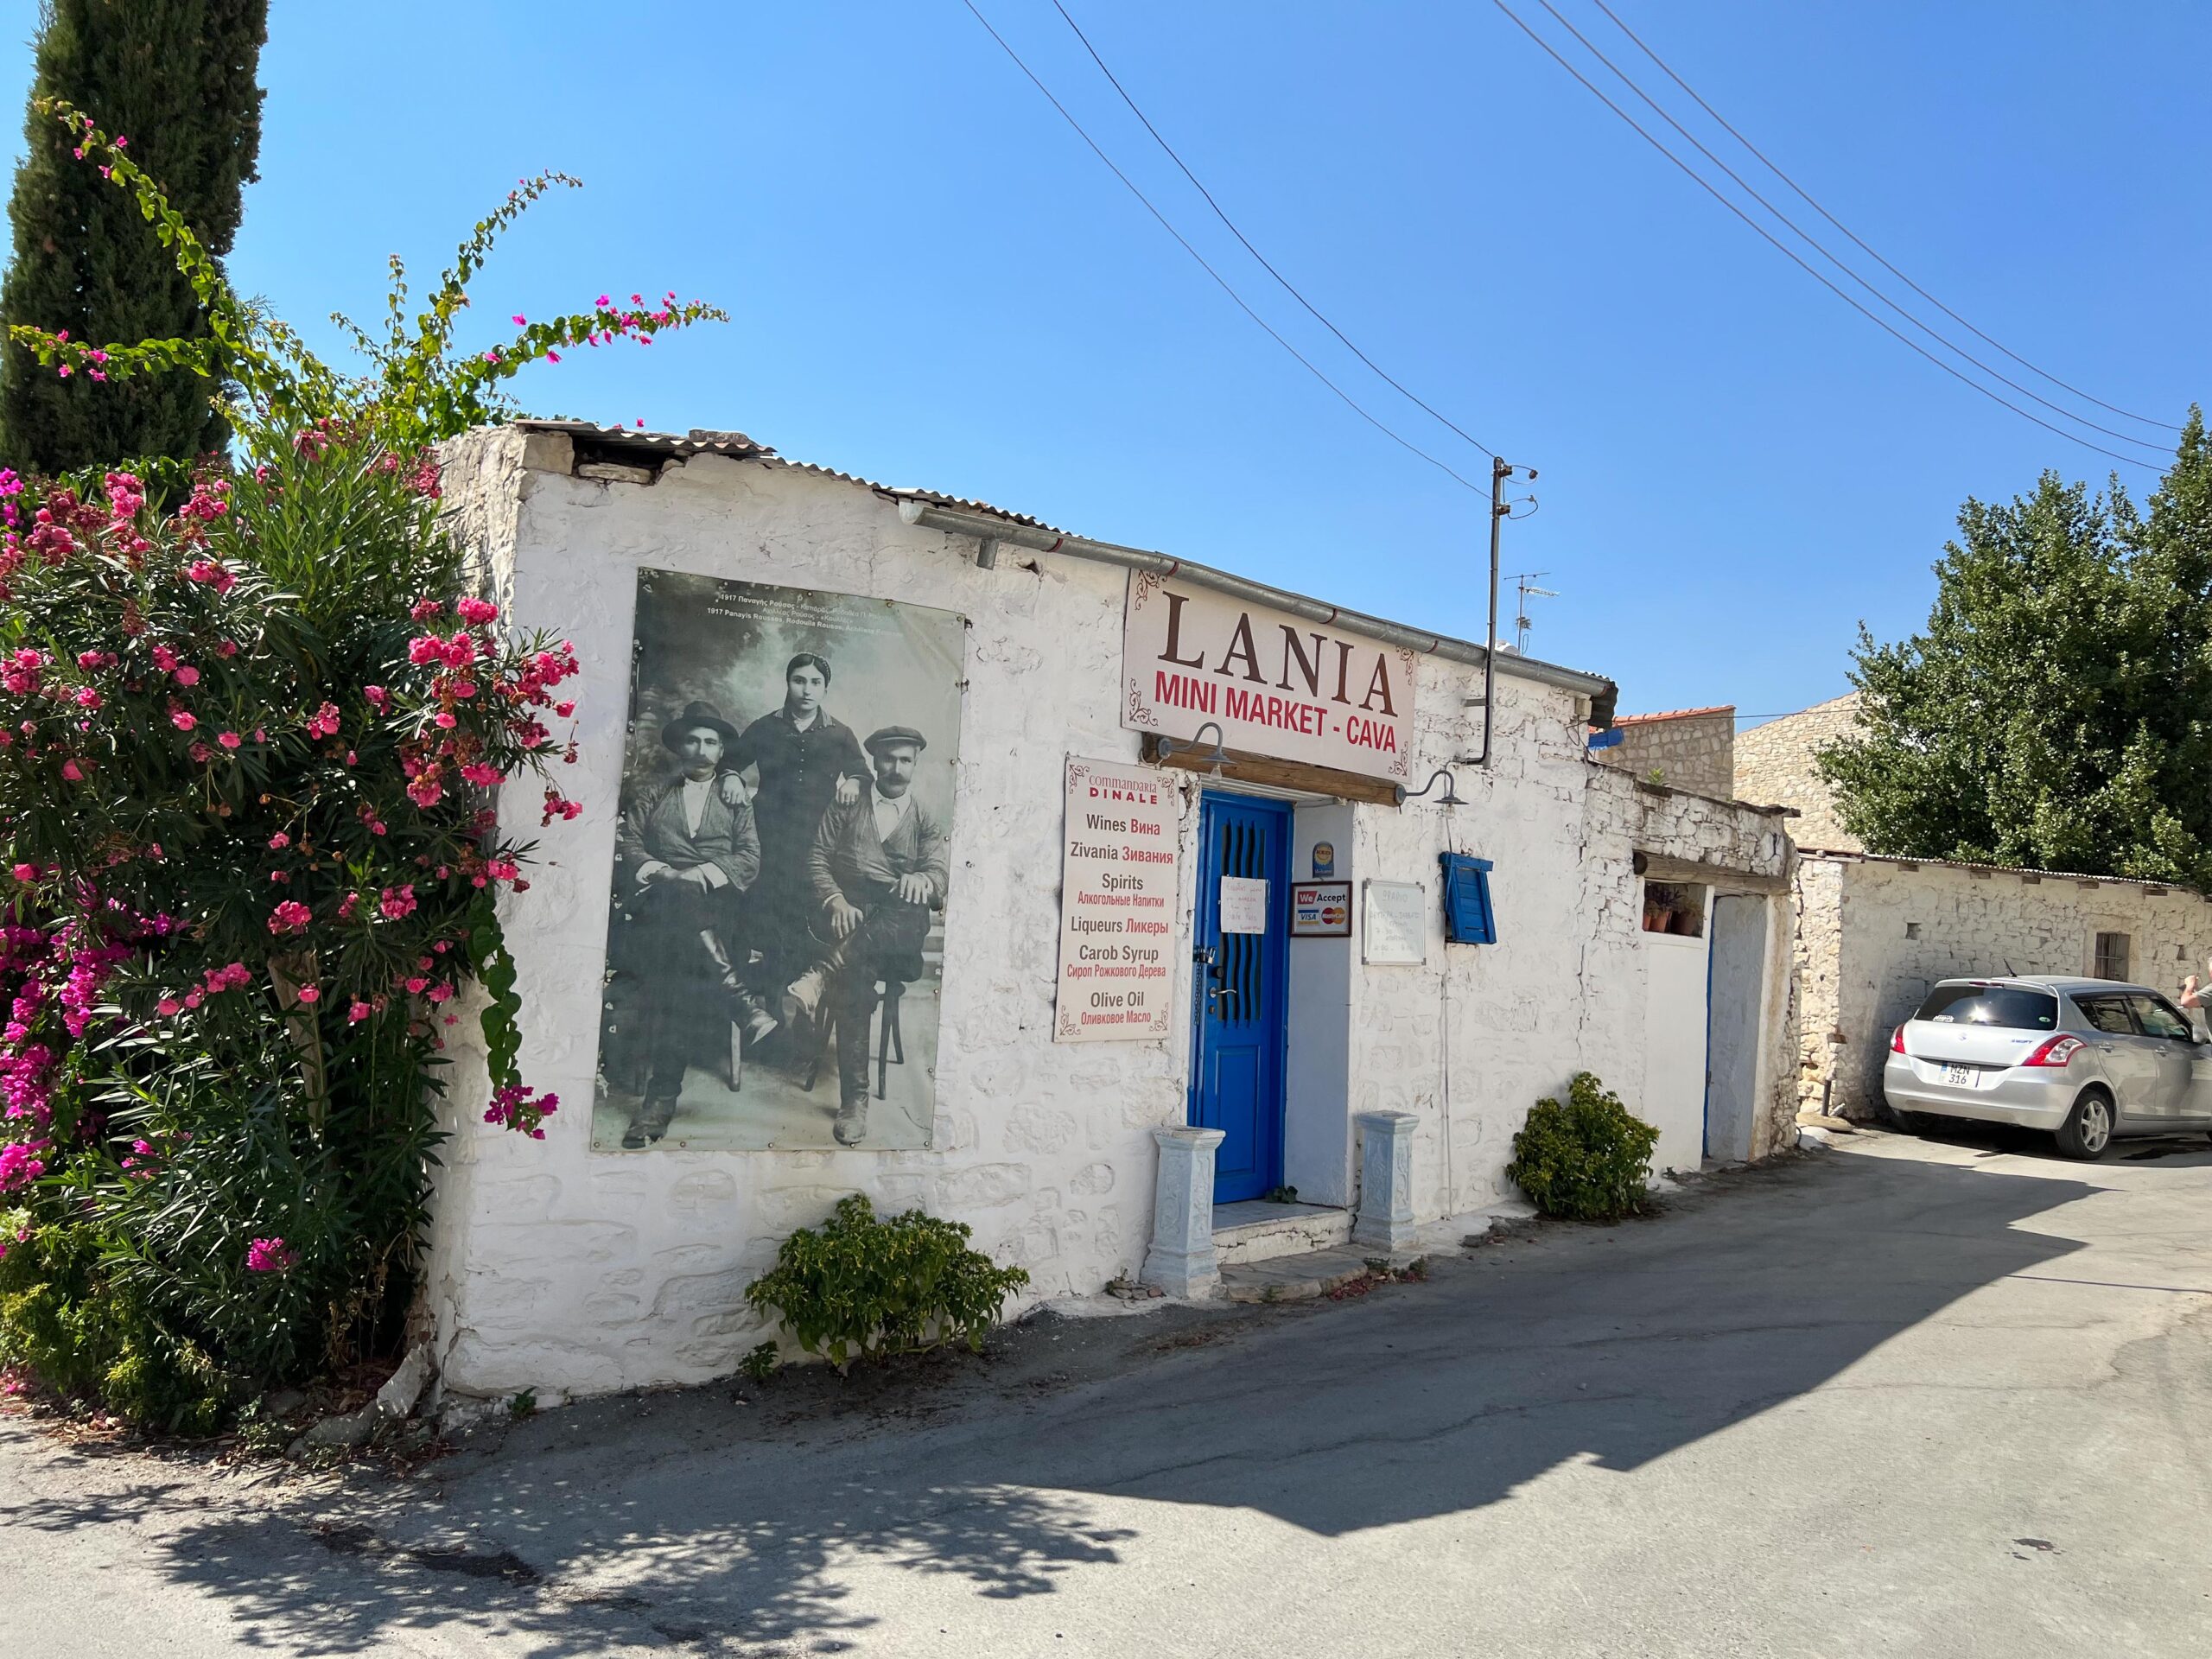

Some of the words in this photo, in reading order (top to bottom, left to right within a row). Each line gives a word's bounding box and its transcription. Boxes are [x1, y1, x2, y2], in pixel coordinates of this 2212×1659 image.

[724, 609, 752, 620] Panayis
[1158, 591, 1398, 718] LANIA
[1154, 671, 1217, 715] MINI
[1226, 687, 1327, 737] MARKET
[1347, 715, 1396, 754] CAVA
[1090, 786, 1158, 804] DINALE
[1086, 813, 1127, 832] Wines
[1130, 818, 1160, 836] Вина
[1070, 842, 1118, 861] Zivania
[1122, 846, 1173, 864] Зивания
[1102, 873, 1144, 892] Spirits
[1077, 890, 1131, 906] Алкогольные
[1133, 893, 1165, 907] Напитки
[1300, 893, 1313, 903] We
[1317, 893, 1346, 904] Accept
[1071, 916, 1122, 935] Liqueurs
[1125, 918, 1169, 937] Ликеры
[1079, 944, 1118, 960] Carob
[1122, 945, 1159, 963] Syrup
[1067, 963, 1092, 980] Сироп
[1094, 963, 1136, 978] Рожкового
[1138, 963, 1166, 979] Дерева
[1090, 992, 1123, 1007] Olive
[1127, 991, 1144, 1007] Oil
[1081, 1011, 1124, 1026] Оливковое
[1126, 1010, 1151, 1024] Масло
[1950, 1064, 1970, 1075] MZN
[1948, 1073, 1967, 1084] 316
